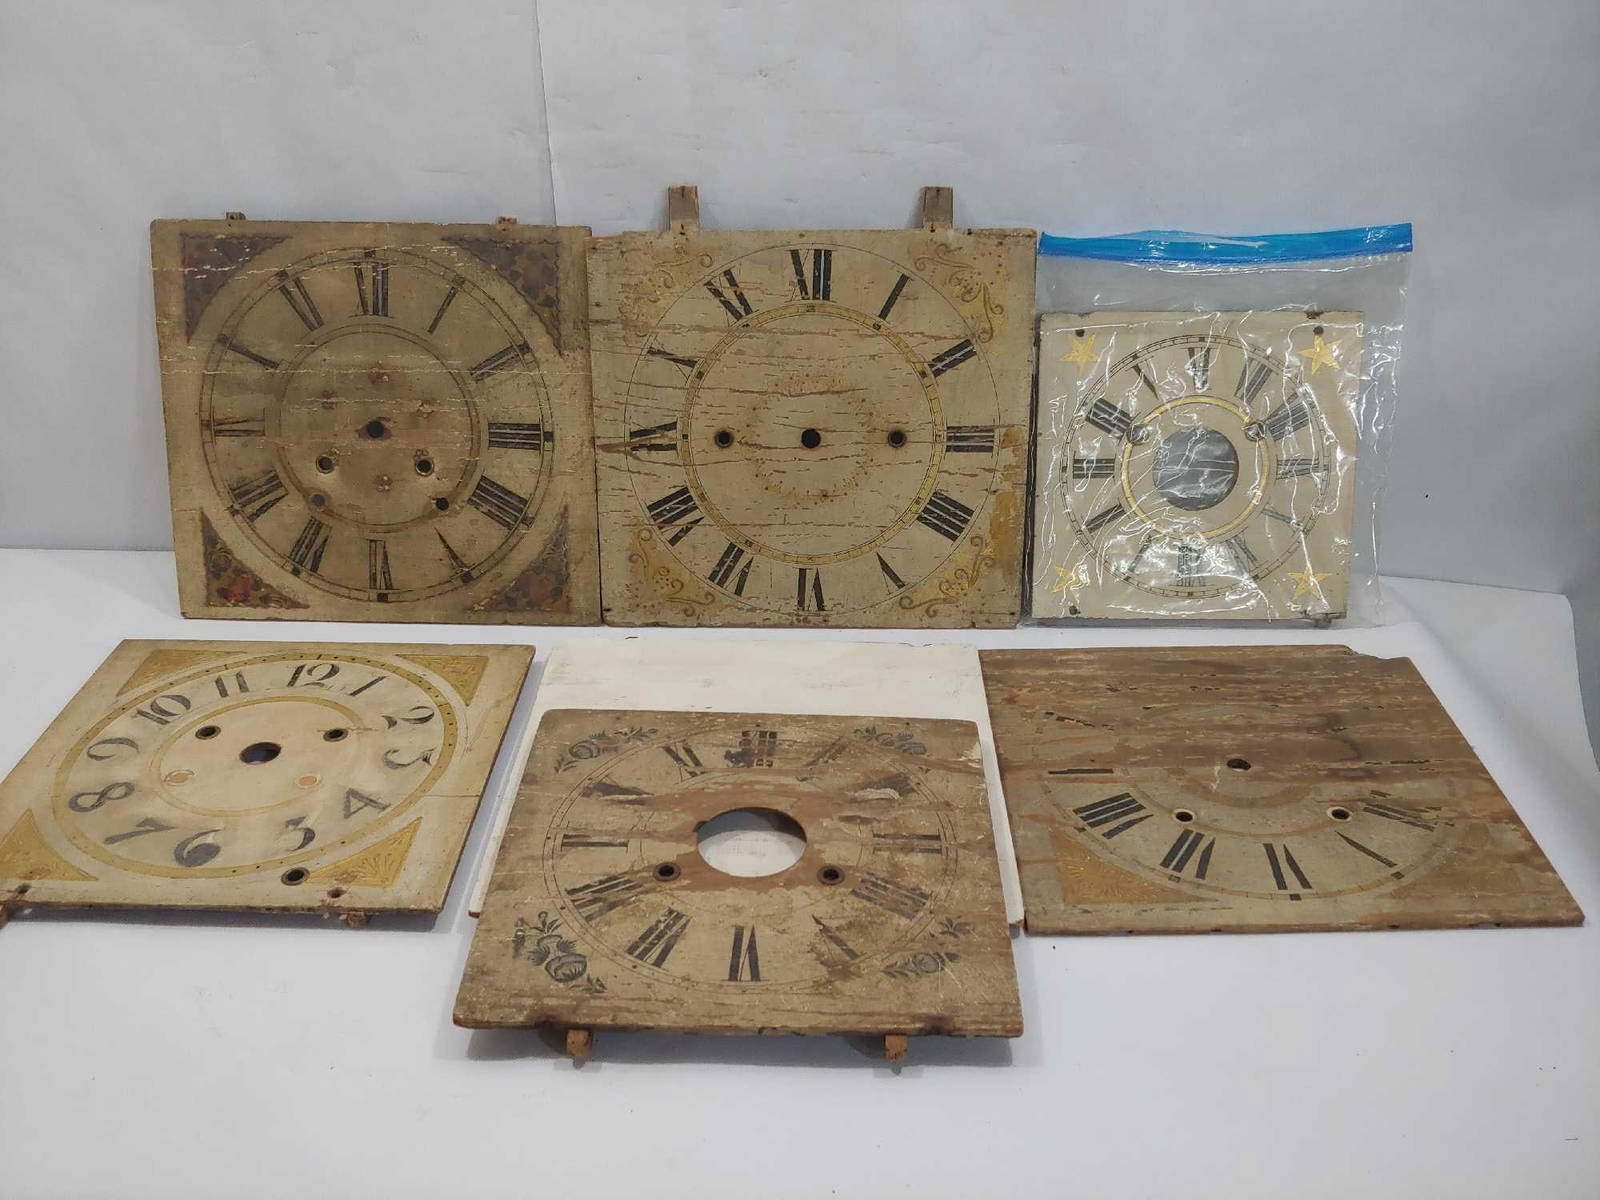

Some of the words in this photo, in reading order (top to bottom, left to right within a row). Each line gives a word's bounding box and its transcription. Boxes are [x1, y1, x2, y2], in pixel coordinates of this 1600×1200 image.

[350, 262, 392, 318] XII
[701, 267, 754, 322] XI
[788, 247, 834, 302] XII
[427, 283, 461, 334] I
[878, 274, 912, 322] I
[926, 337, 980, 379] II
[486, 421, 544, 451] III
[945, 424, 996, 455] III
[1071, 457, 1117, 480] III
[466, 474, 528, 532] IIII
[644, 485, 706, 548] VIII
[914, 490, 976, 545] IIII
[1082, 502, 1127, 535] II
[705, 541, 755, 599] VII
[796, 566, 828, 614] VI
[876, 551, 907, 596] V
[214, 670, 250, 699] 11
[286, 662, 341, 690] 12
[350, 674, 388, 697] 1
[135, 694, 193, 726] 10
[386, 704, 436, 730] 2
[86, 735, 140, 763] 9
[383, 746, 434, 771] 3
[68, 780, 136, 814] 8
[341, 786, 391, 819] 4
[1072, 792, 1154, 840] VIII
[104, 816, 178, 845] 7
[173, 828, 223, 868] 6
[285, 814, 316, 852] 5
[1159, 827, 1217, 881] VII
[1262, 842, 1313, 891] VI
[625, 905, 695, 970] VII
[725, 922, 763, 983] VI
